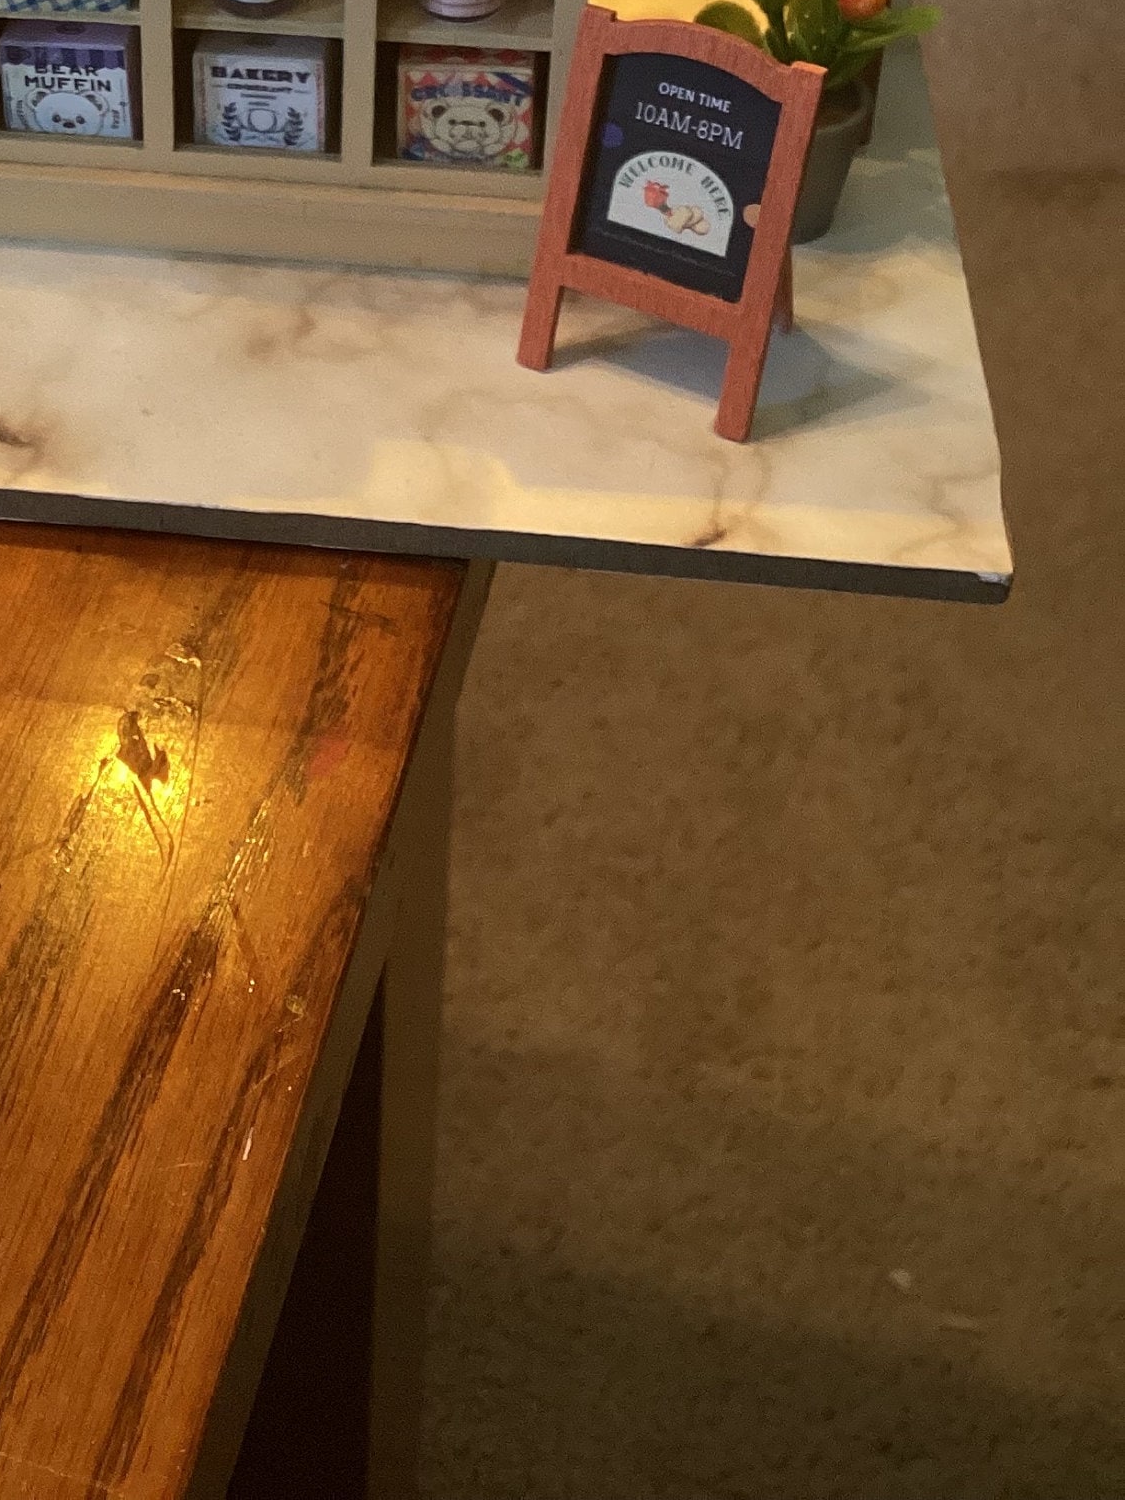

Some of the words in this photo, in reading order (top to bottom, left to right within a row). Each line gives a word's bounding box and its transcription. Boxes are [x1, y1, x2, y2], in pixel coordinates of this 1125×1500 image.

[34, 62, 99, 77] BEAR
[210, 65, 311, 84] BAKERY
[23, 75, 113, 93] MUFFIN
[658, 81, 695, 104] OPEN
[698, 91, 732, 114] TIME
[634, 101, 744, 151] 10AM-8PM
[618, 155, 694, 189] WELCOME
